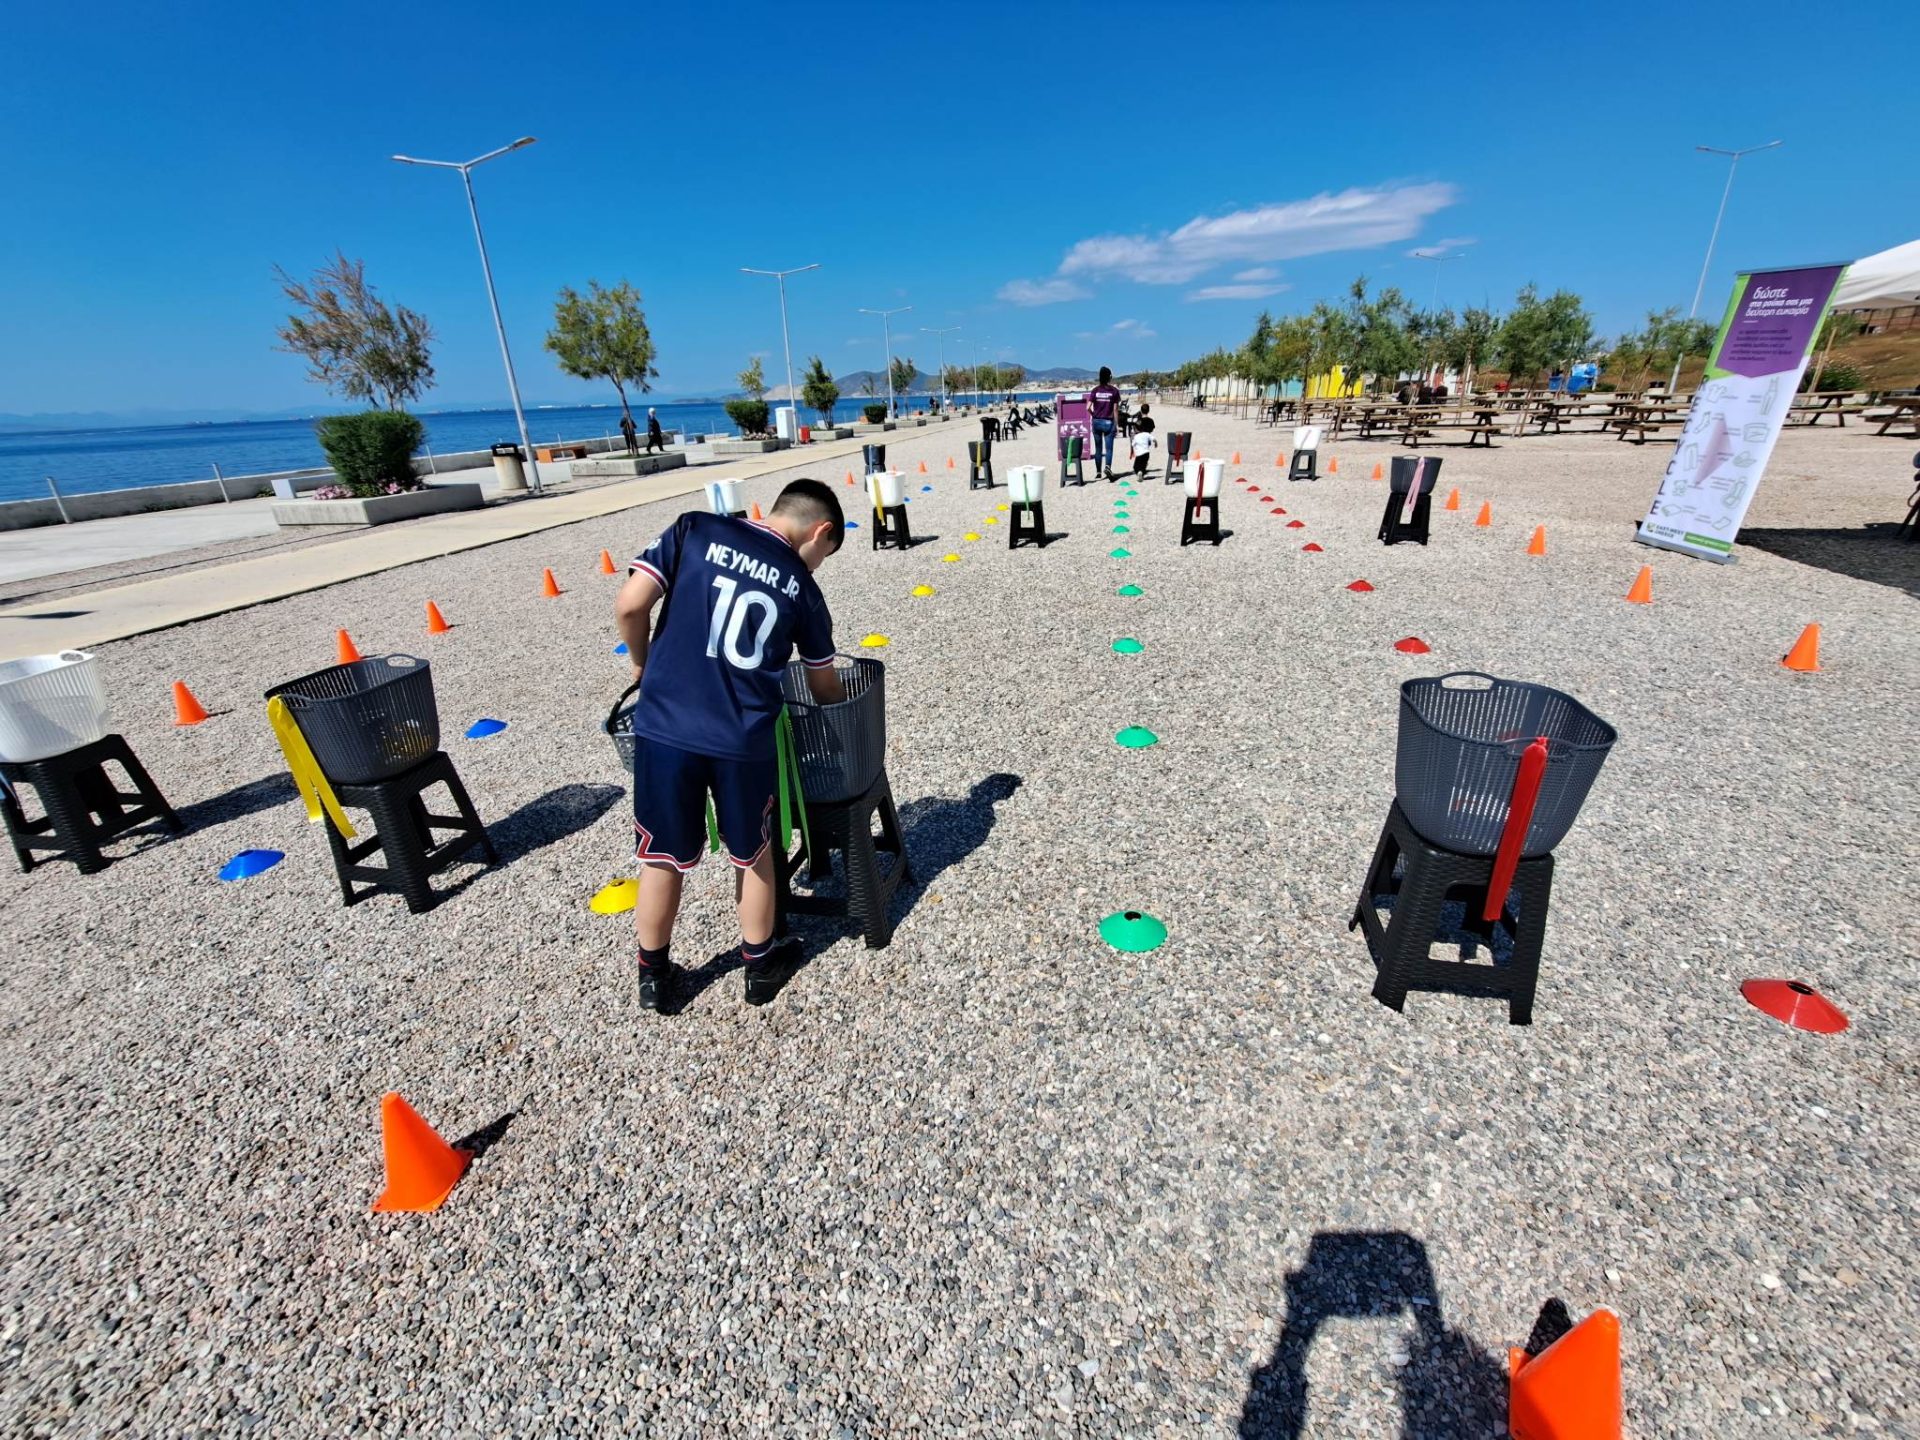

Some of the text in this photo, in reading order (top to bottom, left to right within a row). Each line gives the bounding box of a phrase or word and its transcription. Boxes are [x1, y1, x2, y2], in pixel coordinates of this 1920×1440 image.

[1753, 287, 1788, 298] δώστε
[705, 542, 780, 588] NEYMAR
[706, 575, 778, 670] 10
